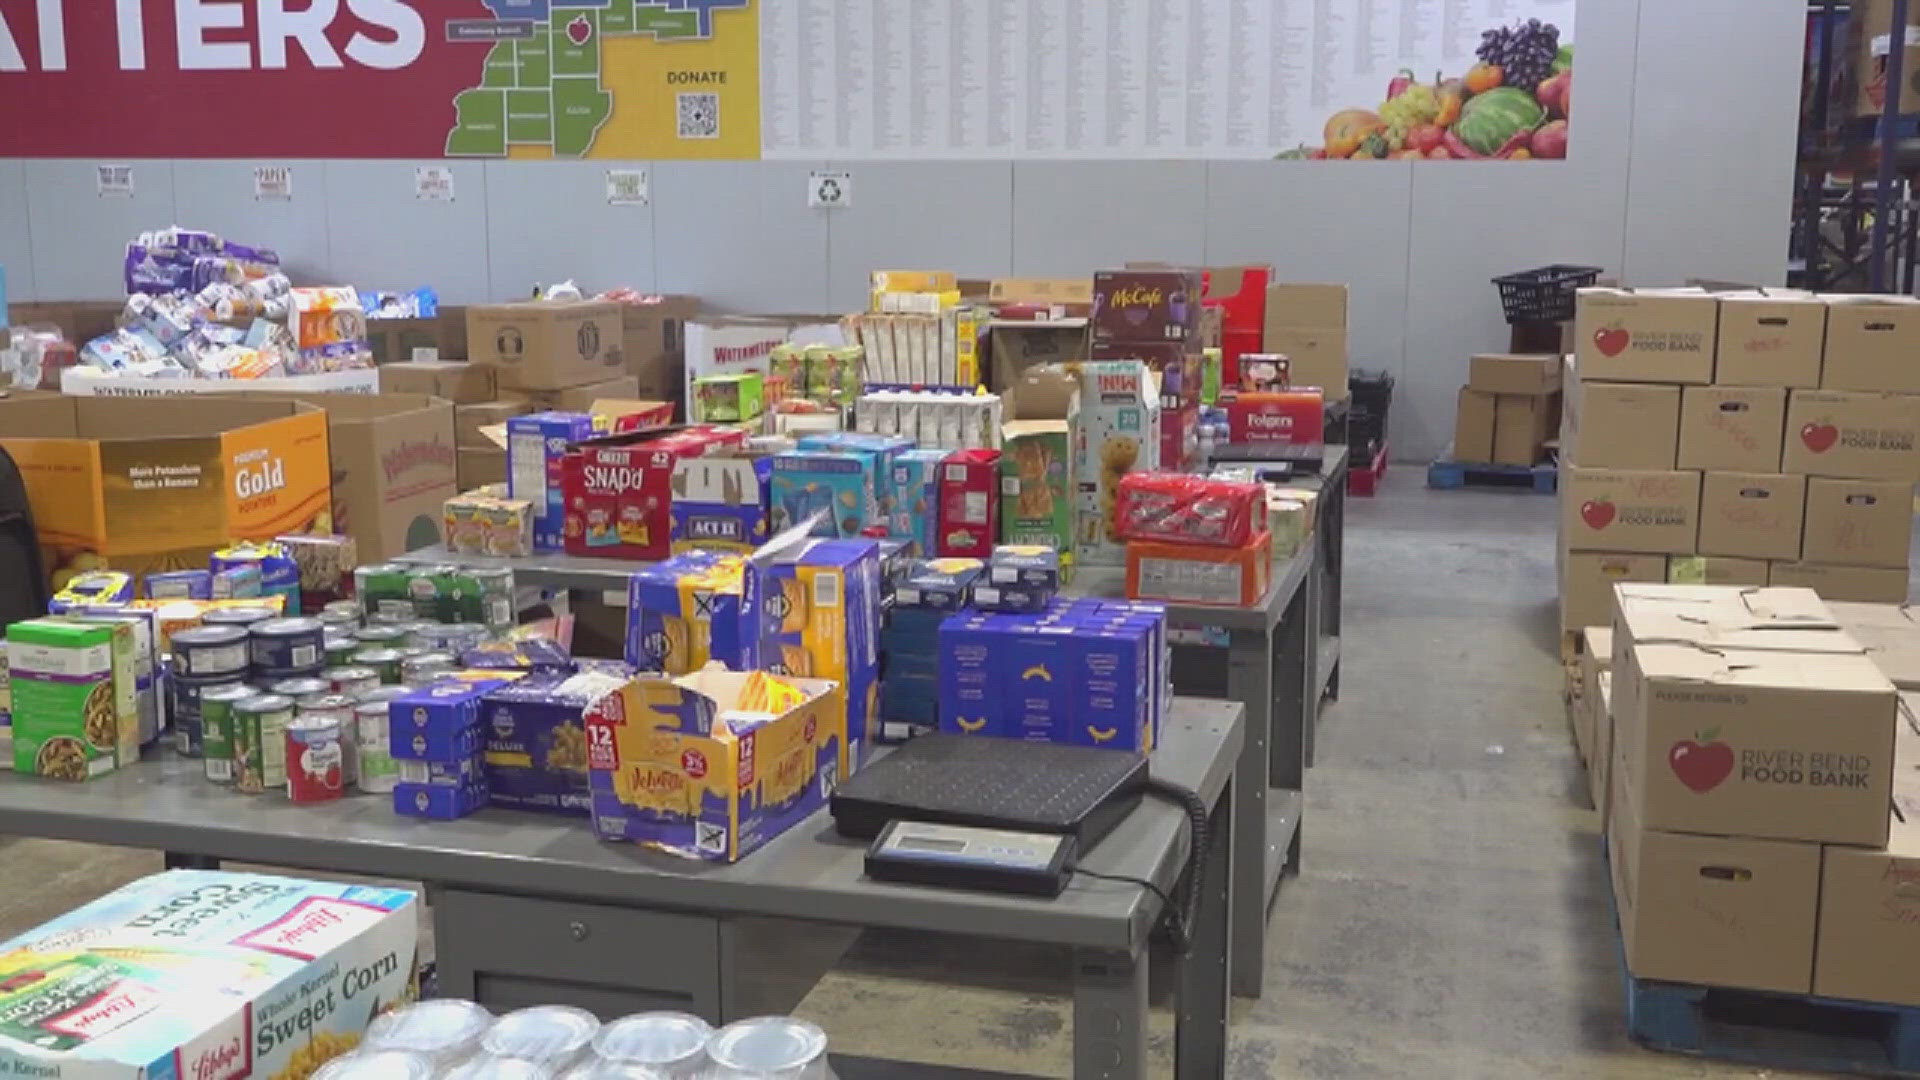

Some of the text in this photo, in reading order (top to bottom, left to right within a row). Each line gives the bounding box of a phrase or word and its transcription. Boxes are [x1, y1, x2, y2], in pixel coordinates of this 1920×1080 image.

[667, 71, 727, 85] DONATE
[1631, 341, 1700, 353] FOOD BANK
[1247, 412, 1293, 429] Folgers
[1840, 438, 1912, 451] FOOD BANK
[652, 453, 669, 464] 42
[130, 464, 201, 477] More Potassium
[235, 457, 286, 498] Gold
[133, 478, 156, 489] than
[165, 477, 199, 488] Banana
[694, 520, 719, 535] ACT
[1619, 516, 1688, 527] FOOD BANK
[588, 724, 613, 745] 12
[740, 736, 754, 759] 12
[1742, 750, 1871, 772] RIVER BEND
[1742, 767, 1869, 789] FOOD BANK
[124, 885, 233, 928] Corn
[256, 961, 340, 1024] Whole Kernel
[256, 951, 399, 1057] Sweet Corn
[14, 1057, 61, 1078] Kernel
